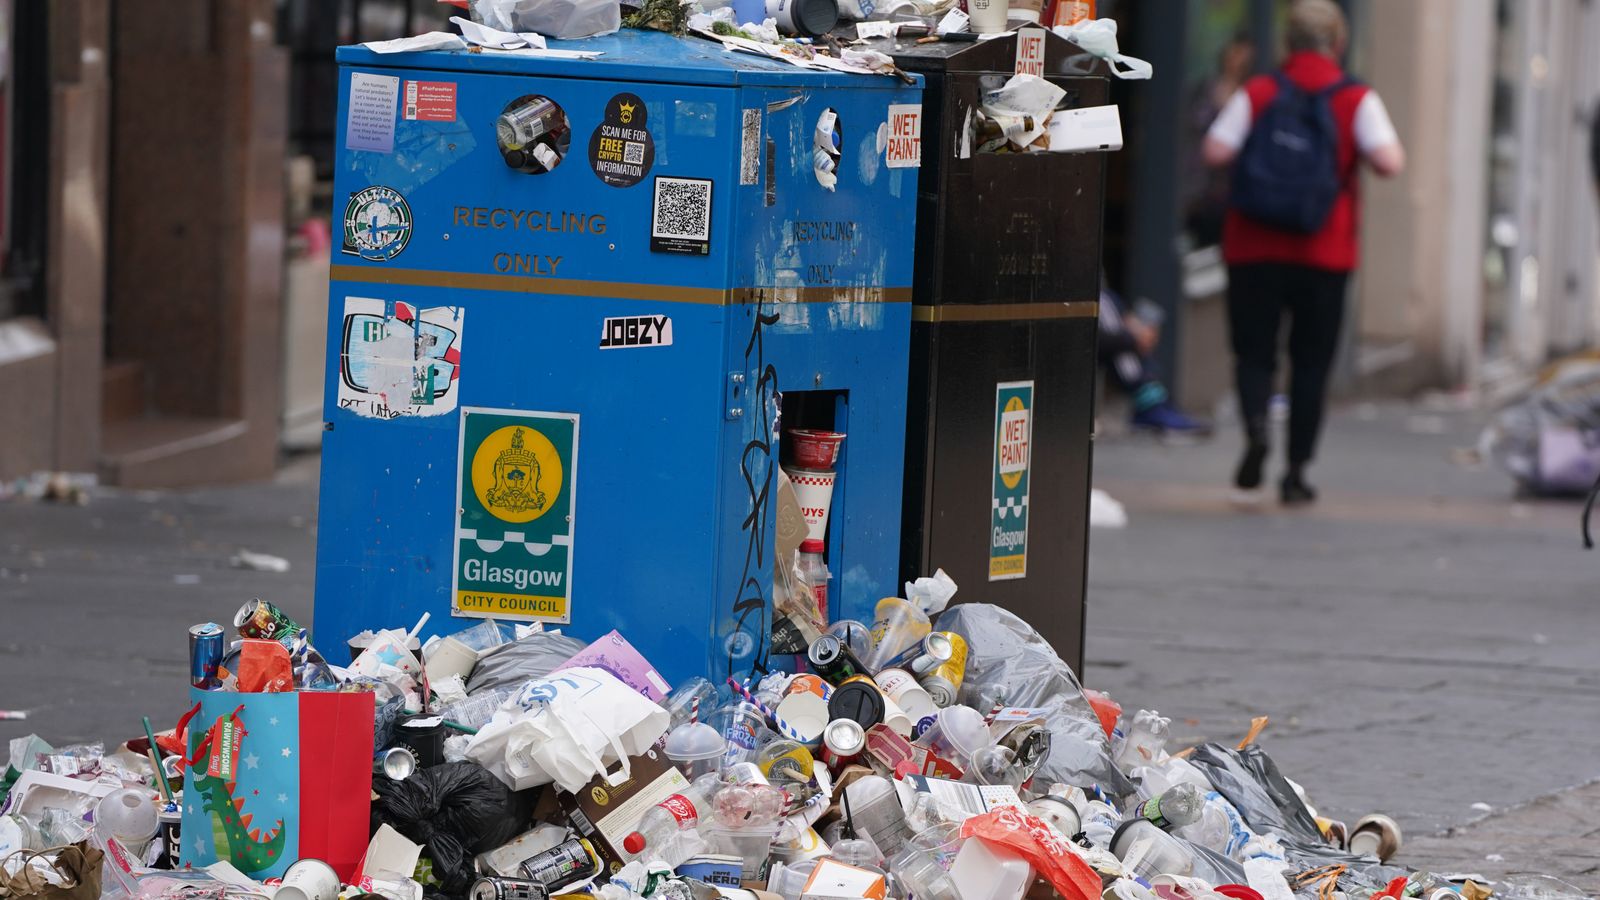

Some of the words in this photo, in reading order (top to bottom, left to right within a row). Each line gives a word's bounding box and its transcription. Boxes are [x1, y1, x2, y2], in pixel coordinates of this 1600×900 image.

[1021, 37, 1041, 60] WET
[1017, 61, 1042, 77] PAINT
[602, 125, 620, 138] SCAN
[621, 128, 632, 140] ME
[633, 130, 646, 141] FOR
[893, 114, 917, 136] WET
[600, 138, 623, 152] FREE
[888, 138, 920, 160] PAINT
[598, 150, 621, 161] CRYPTO
[596, 160, 642, 176] INFORMATION
[453, 206, 607, 234] RECYCLING
[792, 221, 854, 241] RECYCLING
[493, 252, 563, 276] ONLY
[807, 264, 836, 284] ONLY
[1005, 419, 1026, 442] WET
[1002, 442, 1027, 466] PAINT
[802, 507, 824, 517] UYS
[993, 526, 1025, 551] Glasgow
[463, 558, 563, 590] Glasgow
[463, 595, 496, 608] CITY
[499, 598, 559, 613] COUNCIL
[703, 874, 739, 885] NERO
